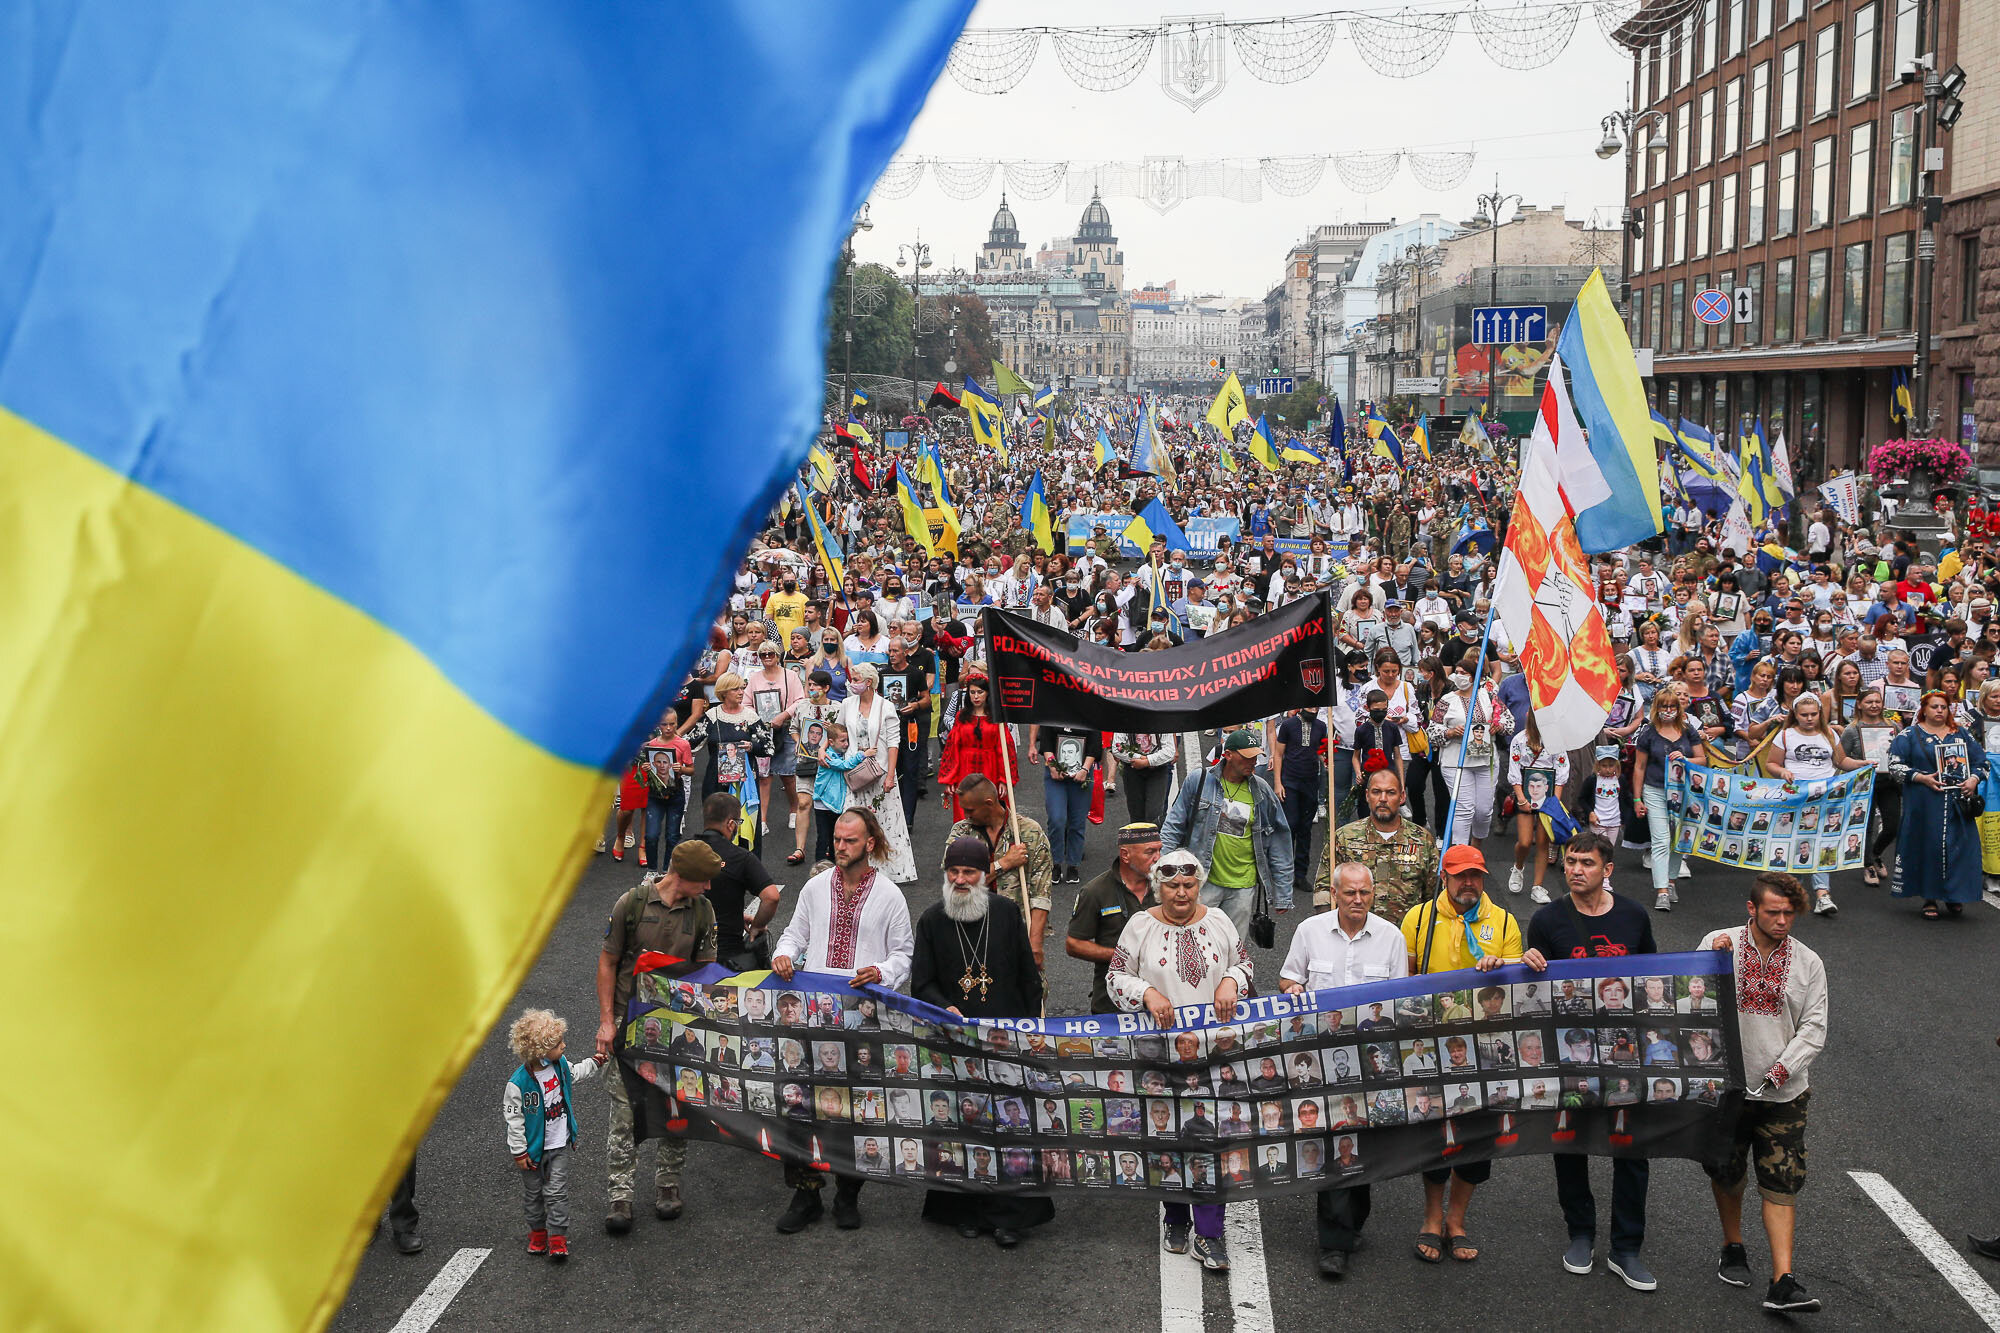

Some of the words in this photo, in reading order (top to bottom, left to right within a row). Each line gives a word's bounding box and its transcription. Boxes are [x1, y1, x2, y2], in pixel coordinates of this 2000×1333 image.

[993, 635, 1075, 668] РОДИНИ
[1078, 661, 1196, 683] ЗАГИБЛИХ
[1212, 617, 1325, 673] ПОМЕРЛИХ
[1042, 669, 1180, 701] ЗАХИСНИКІВ
[1183, 661, 1278, 699] УКРАЇНИ
[963, 1016, 1046, 1033] ЕРОЇ
